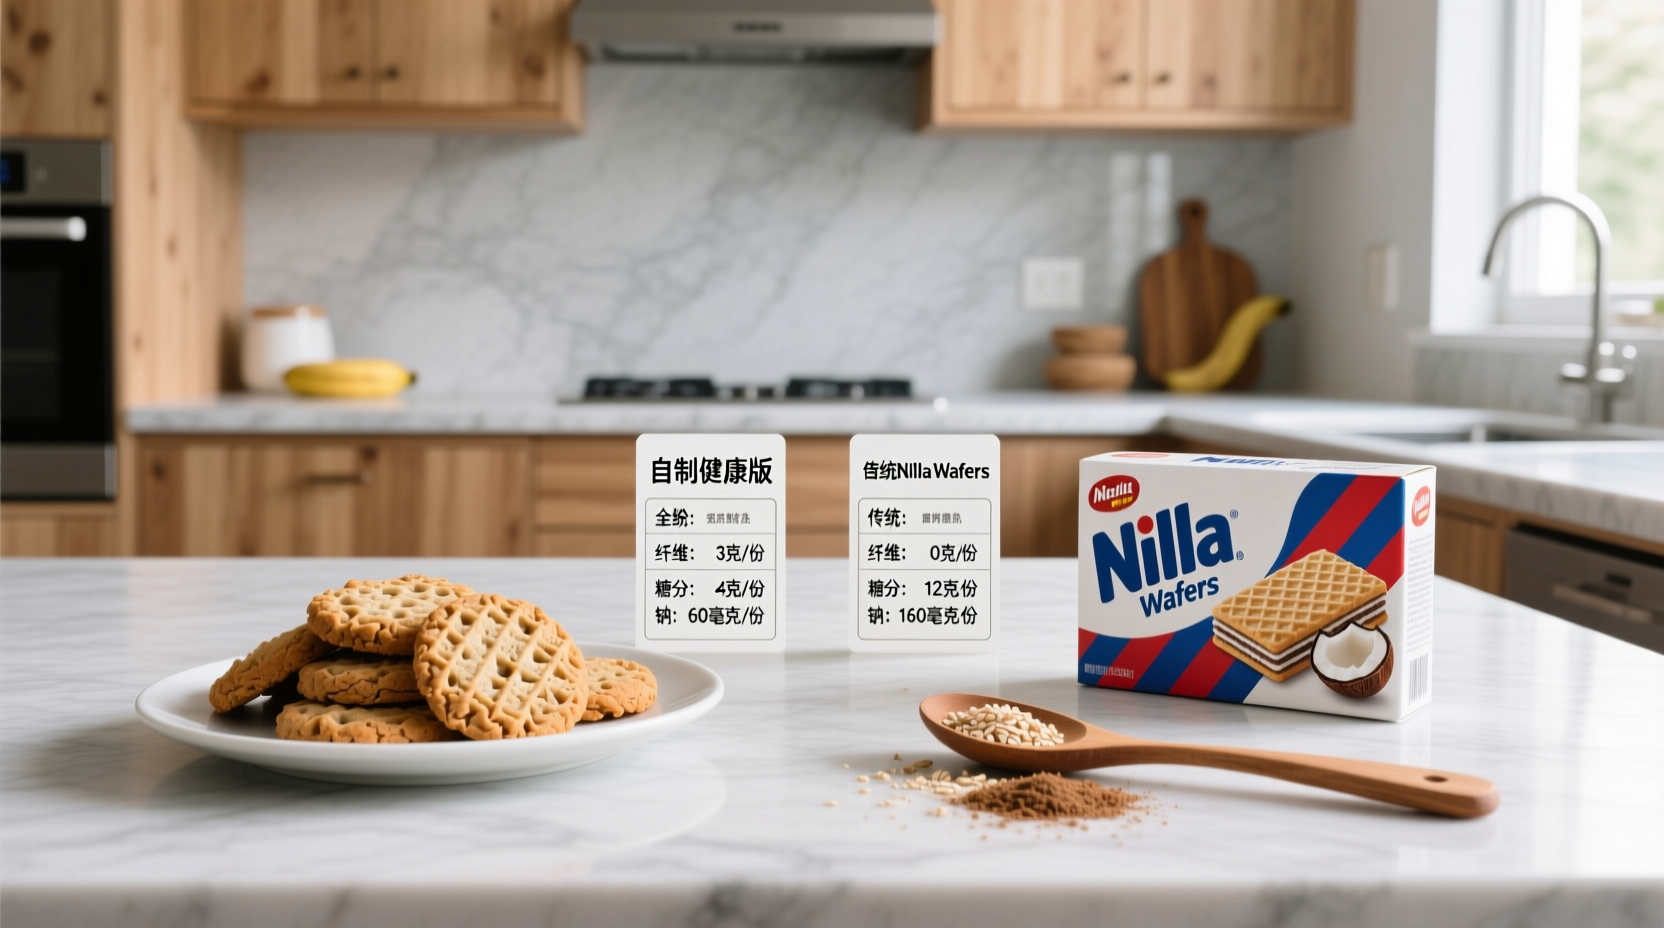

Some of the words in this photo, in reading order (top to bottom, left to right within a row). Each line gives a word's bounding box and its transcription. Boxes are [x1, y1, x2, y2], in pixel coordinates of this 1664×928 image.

[652, 457, 772, 484] 自制健康版
[933, 463, 990, 479] Wafers
[716, 543, 765, 562] 3克/份
[930, 543, 977, 562] 0克/份
[1092, 502, 1234, 604] Nilla
[715, 579, 765, 598] 4克/份
[925, 579, 978, 598] 12克份
[1139, 576, 1219, 618] Wafers
